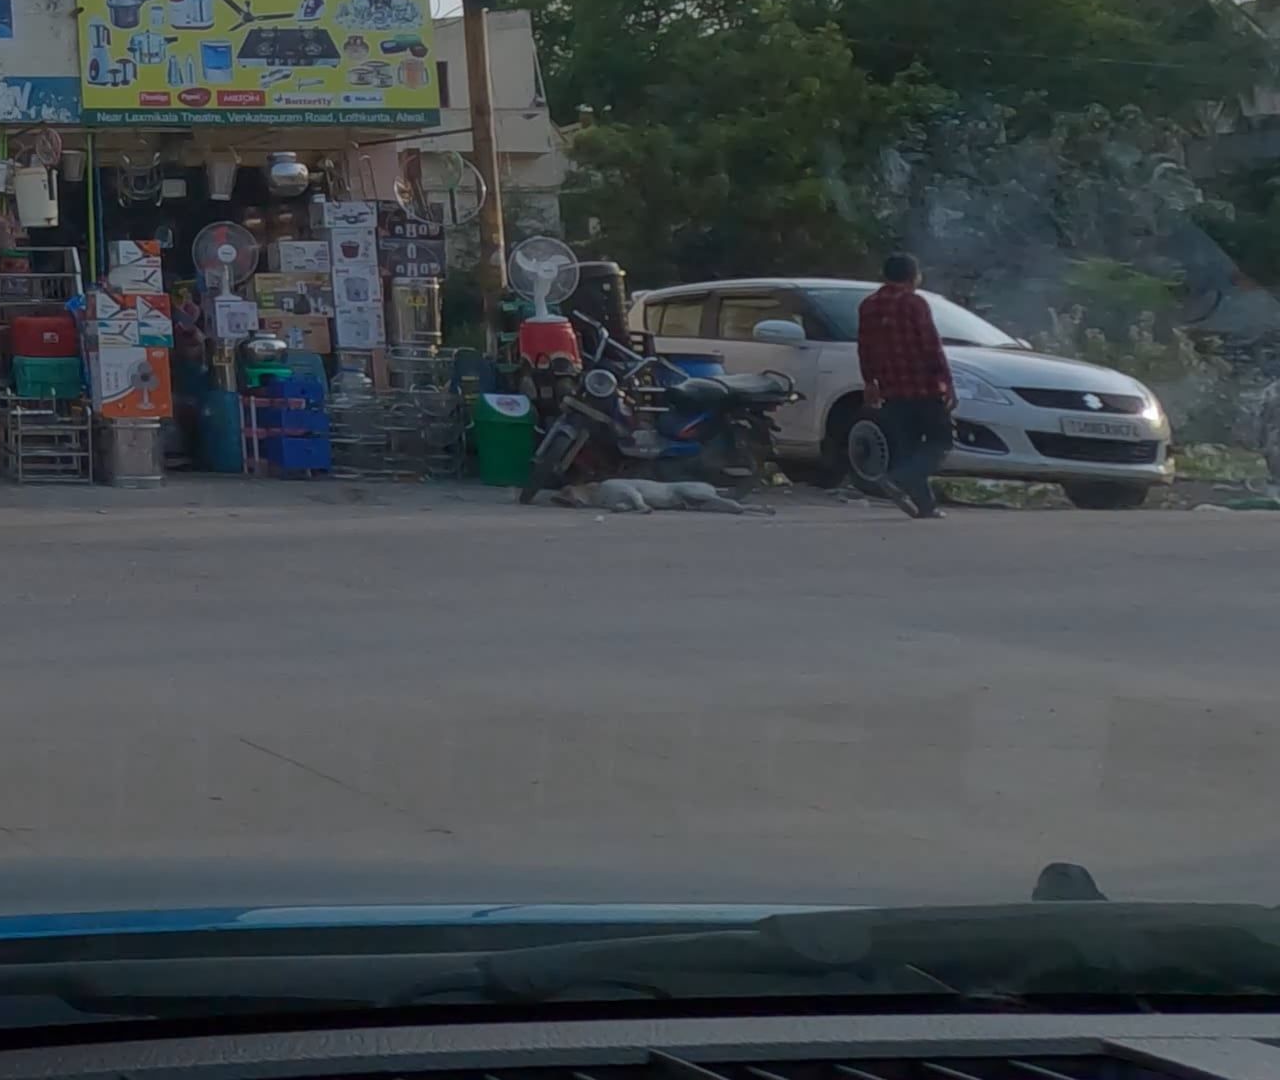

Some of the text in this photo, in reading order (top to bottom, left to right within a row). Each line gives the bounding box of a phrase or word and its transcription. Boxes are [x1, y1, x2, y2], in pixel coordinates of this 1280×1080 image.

[285, 95, 332, 106] Butterfly
[96, 112, 123, 122] Near
[125, 112, 178, 122] Laxmikala
[182, 112, 225, 123] Theatre,
[227, 112, 302, 124] Venkatapuram
[305, 112, 337, 123] Road,
[339, 112, 393, 123] Lothkunta,
